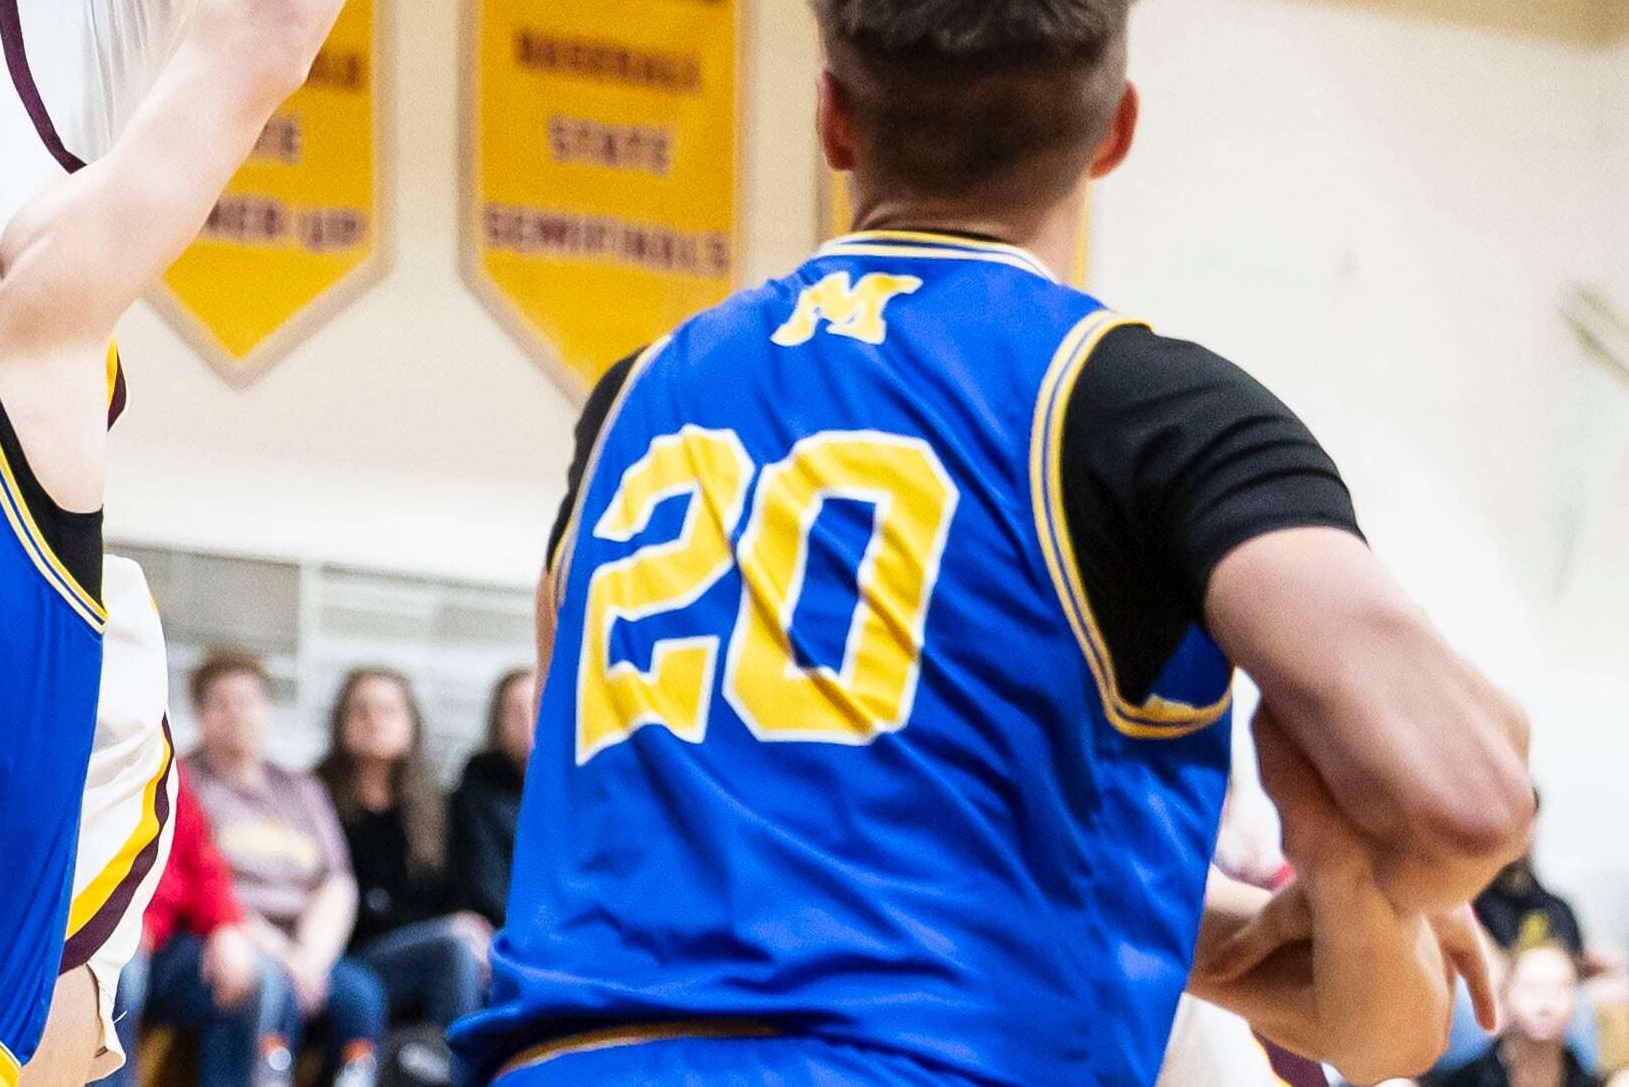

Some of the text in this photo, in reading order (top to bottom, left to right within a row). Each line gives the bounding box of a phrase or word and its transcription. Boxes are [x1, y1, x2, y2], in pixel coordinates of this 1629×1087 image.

[513, 27, 703, 97] BASEBALL
[546, 115, 672, 179] STATE
[203, 194, 286, 246] NER
[484, 202, 730, 278] SEMIFINALS
[771, 271, 923, 346] M
[576, 423, 960, 767] 20
